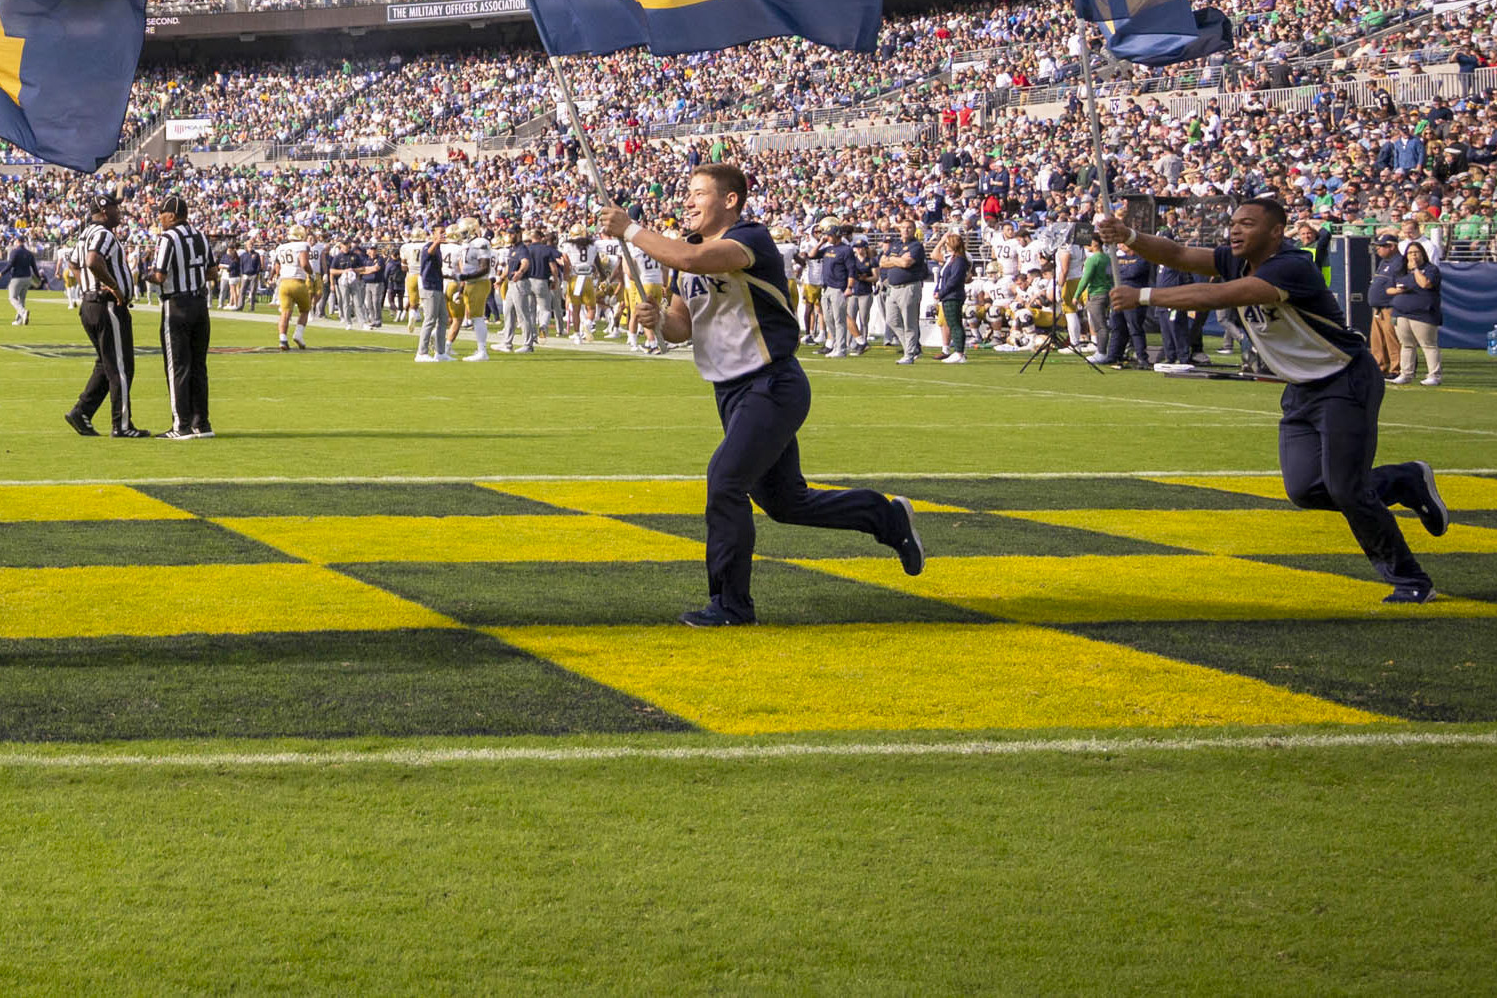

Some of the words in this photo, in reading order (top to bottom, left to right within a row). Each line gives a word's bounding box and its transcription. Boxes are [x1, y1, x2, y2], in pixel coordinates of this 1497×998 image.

[392, 6, 407, 19] THE
[408, 3, 443, 18] MILITARY
[445, 1, 479, 16] OFFICERS
[146, 17, 180, 26] SECOND.
[280, 249, 294, 264] 56
[579, 248, 588, 262] 8
[997, 245, 1011, 259] 79
